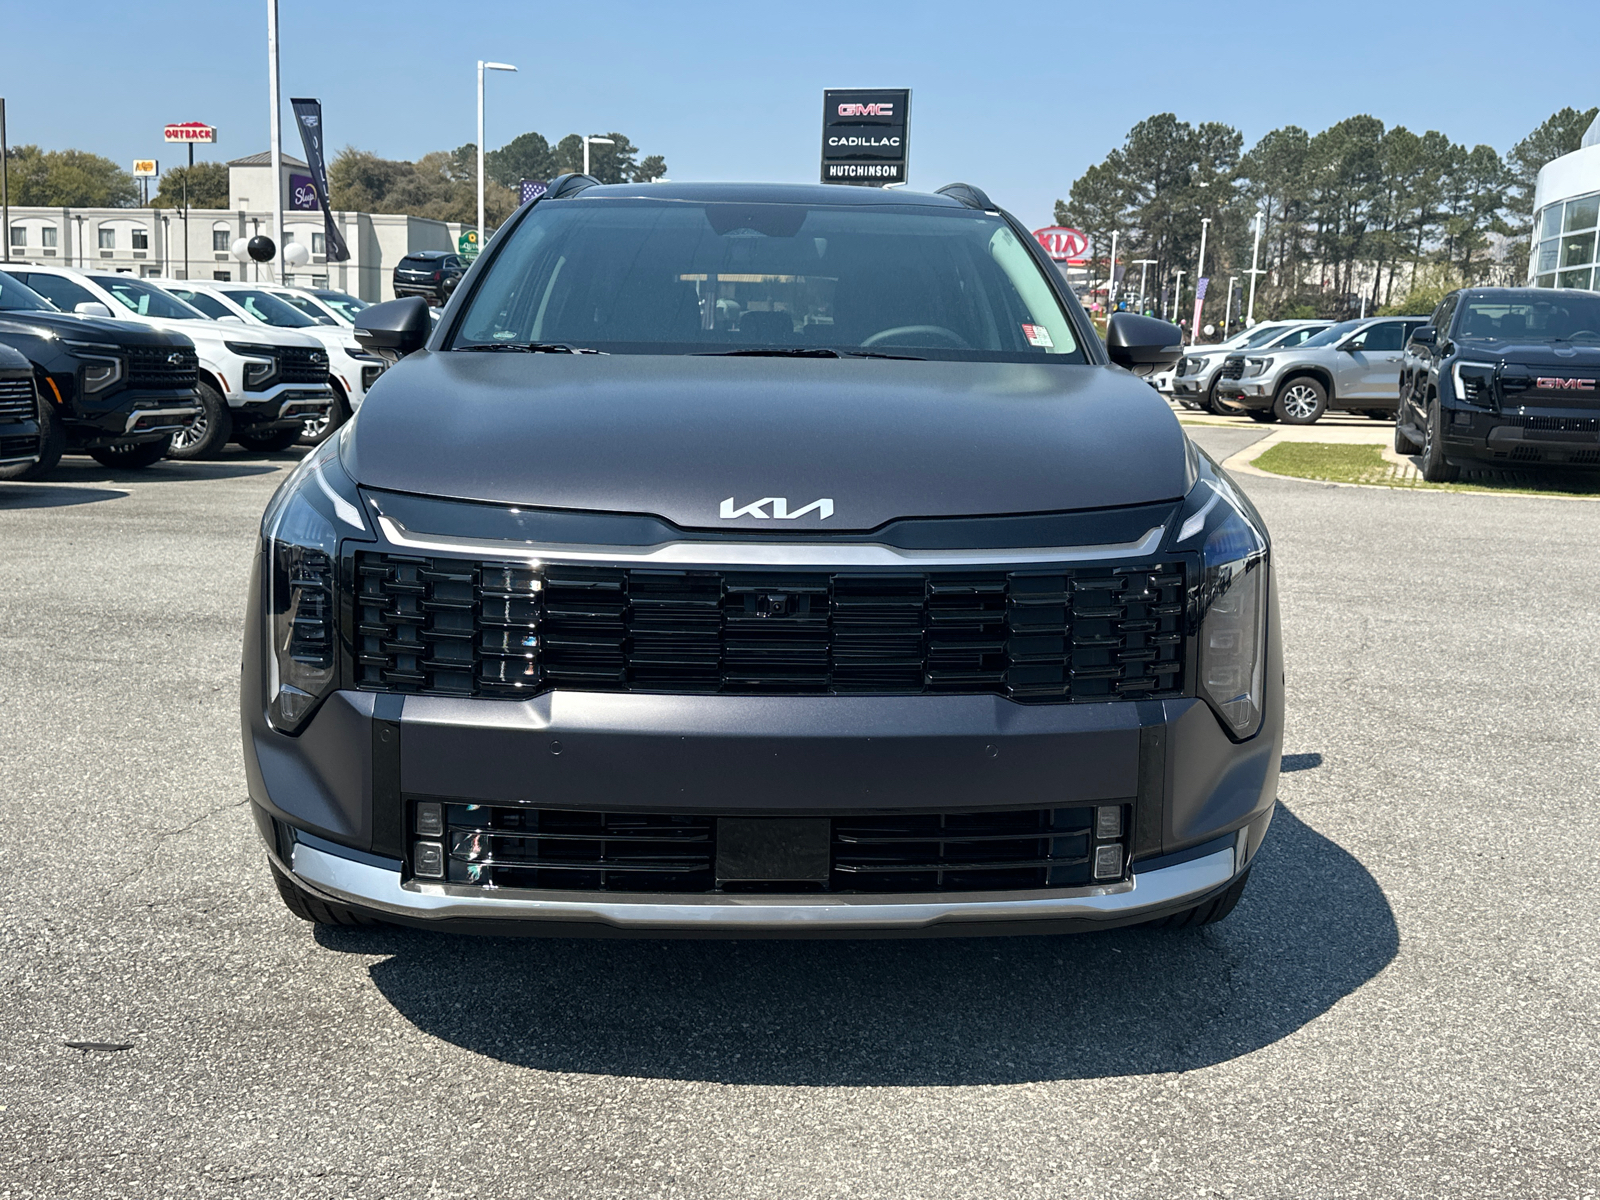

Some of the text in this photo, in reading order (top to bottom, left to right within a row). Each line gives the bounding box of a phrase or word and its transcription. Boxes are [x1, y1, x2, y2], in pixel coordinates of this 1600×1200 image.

[838, 103, 893, 116] GMC
[165, 130, 211, 138] OUTBACK
[828, 137, 900, 146] CADILLAC
[829, 165, 897, 177] HUTCHINSON
[295, 187, 315, 206] Sleep
[1038, 234, 1078, 253] KIA
[1536, 377, 1596, 390] GMC
[720, 497, 834, 520] KIA
